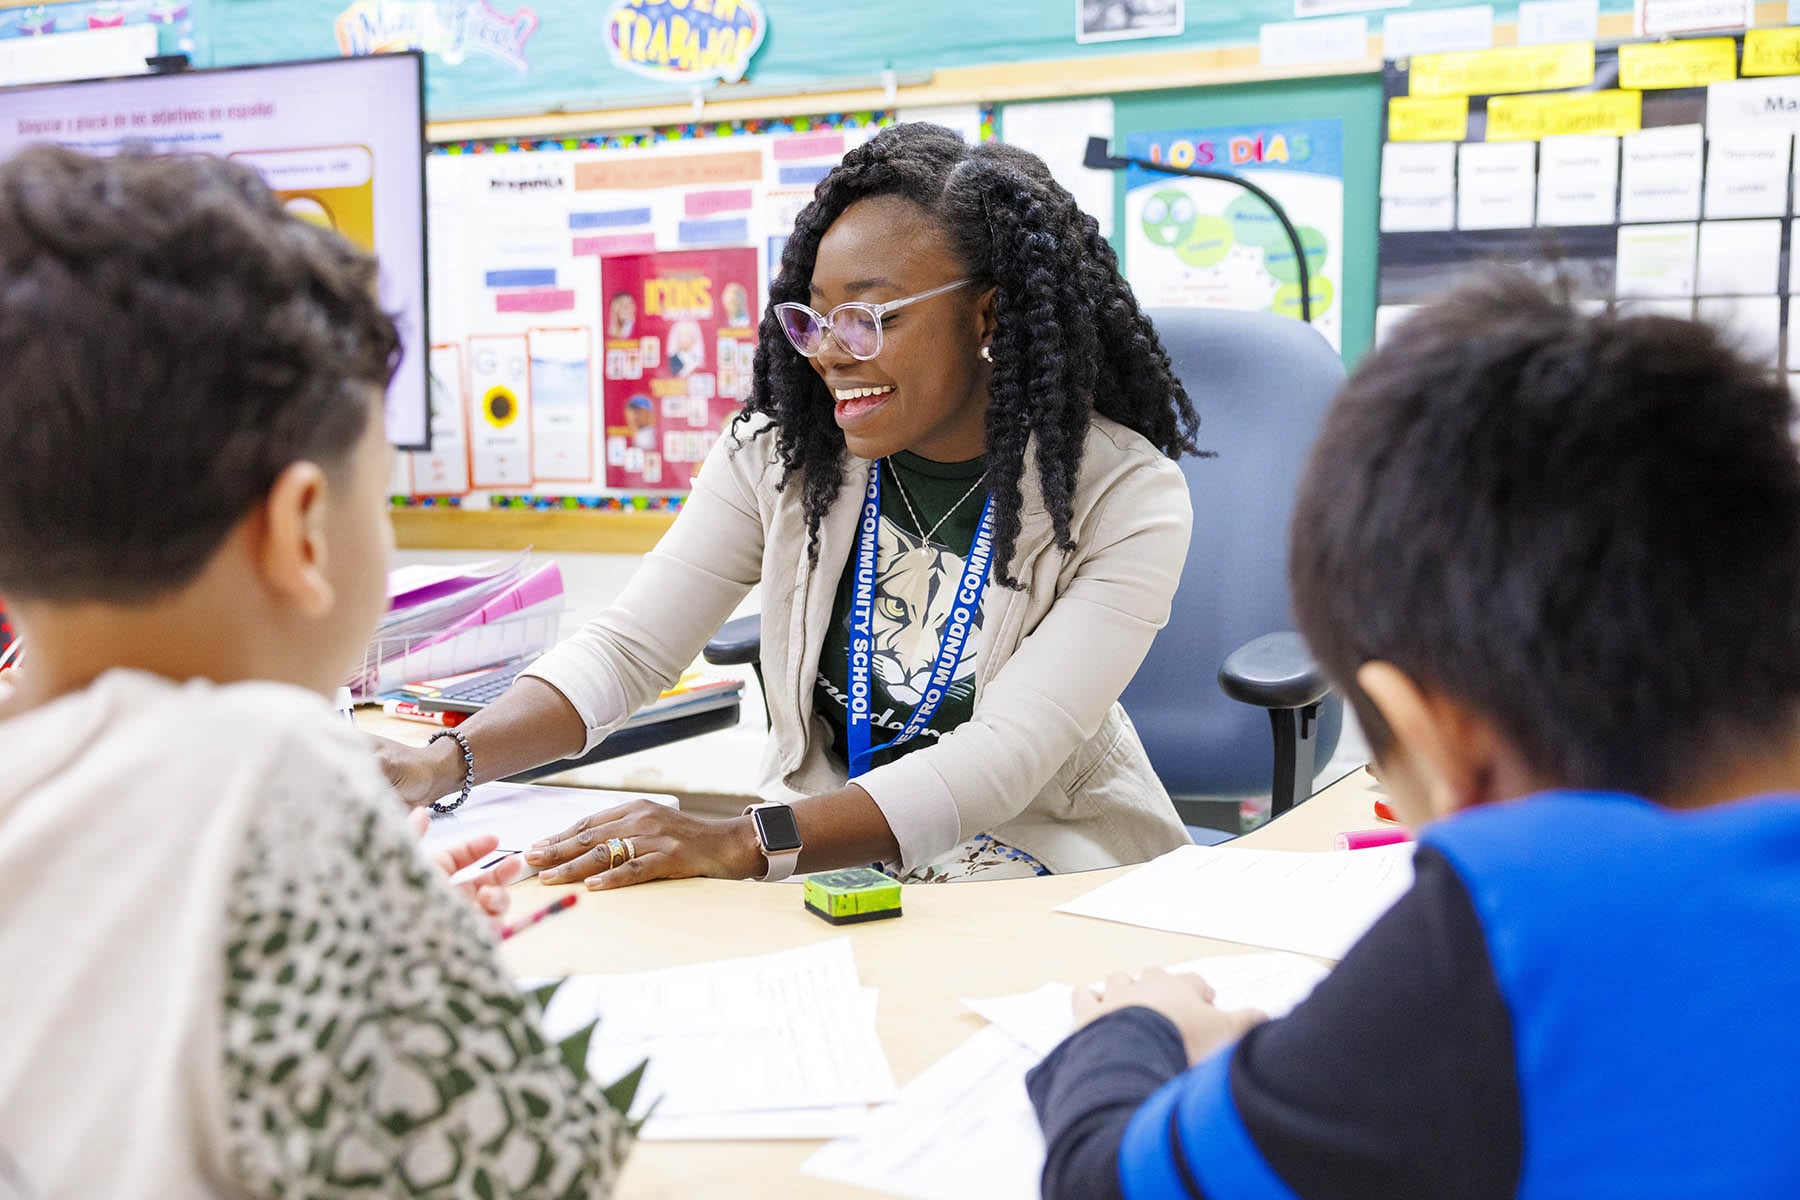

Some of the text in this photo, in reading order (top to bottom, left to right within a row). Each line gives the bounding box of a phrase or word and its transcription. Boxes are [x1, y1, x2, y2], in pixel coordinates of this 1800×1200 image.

[1150, 132, 1310, 169] LOS DÍAS
[853, 502, 877, 637] COMMUNITY
[851, 638, 871, 726] SCHOOL
[892, 688, 941, 745] ESTRO
[933, 606, 971, 687] MUNDO
